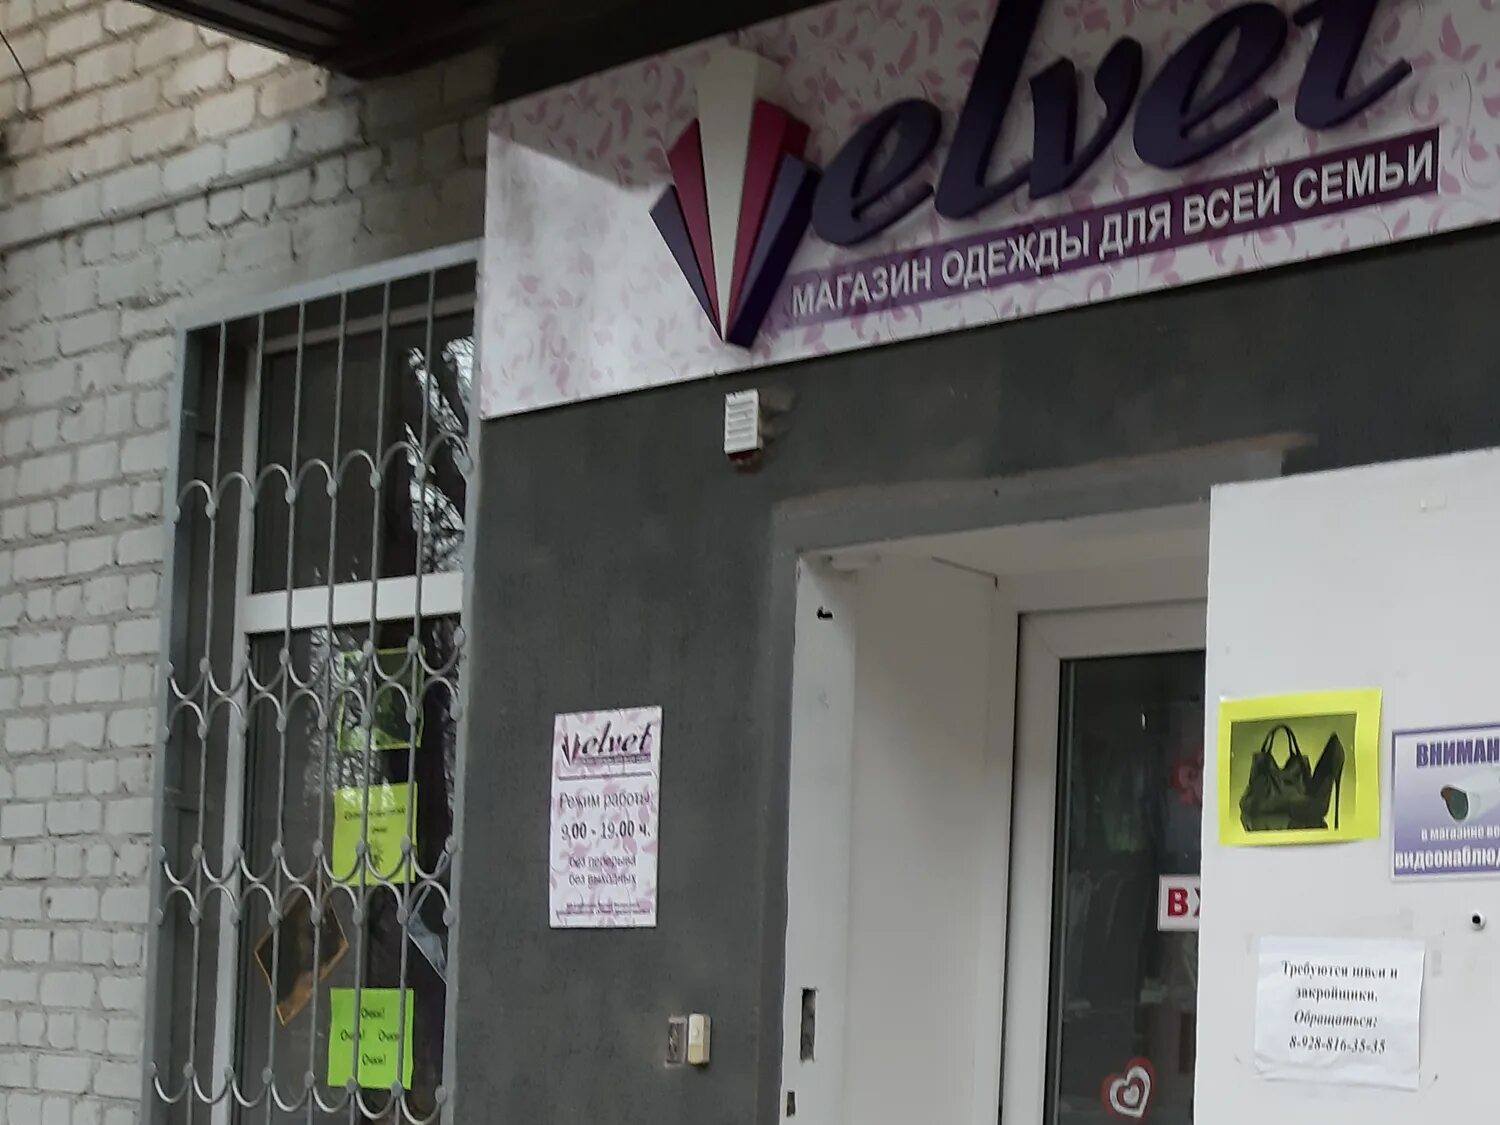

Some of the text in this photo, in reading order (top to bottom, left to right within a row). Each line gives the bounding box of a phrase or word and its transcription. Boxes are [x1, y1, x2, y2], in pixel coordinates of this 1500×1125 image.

[791, 141, 1433, 317] МАГАЗИН ОДЕЖДЫ ДЛЯ ВСЕЙ СЕМЬИ
[560, 791, 600, 809] Режим
[601, 820, 634, 840] 19.00
[1430, 826, 1484, 841] магазине
[1281, 960, 1348, 980] Требуются
[1289, 1035, 1386, 1055] 8-928-816-35-35
